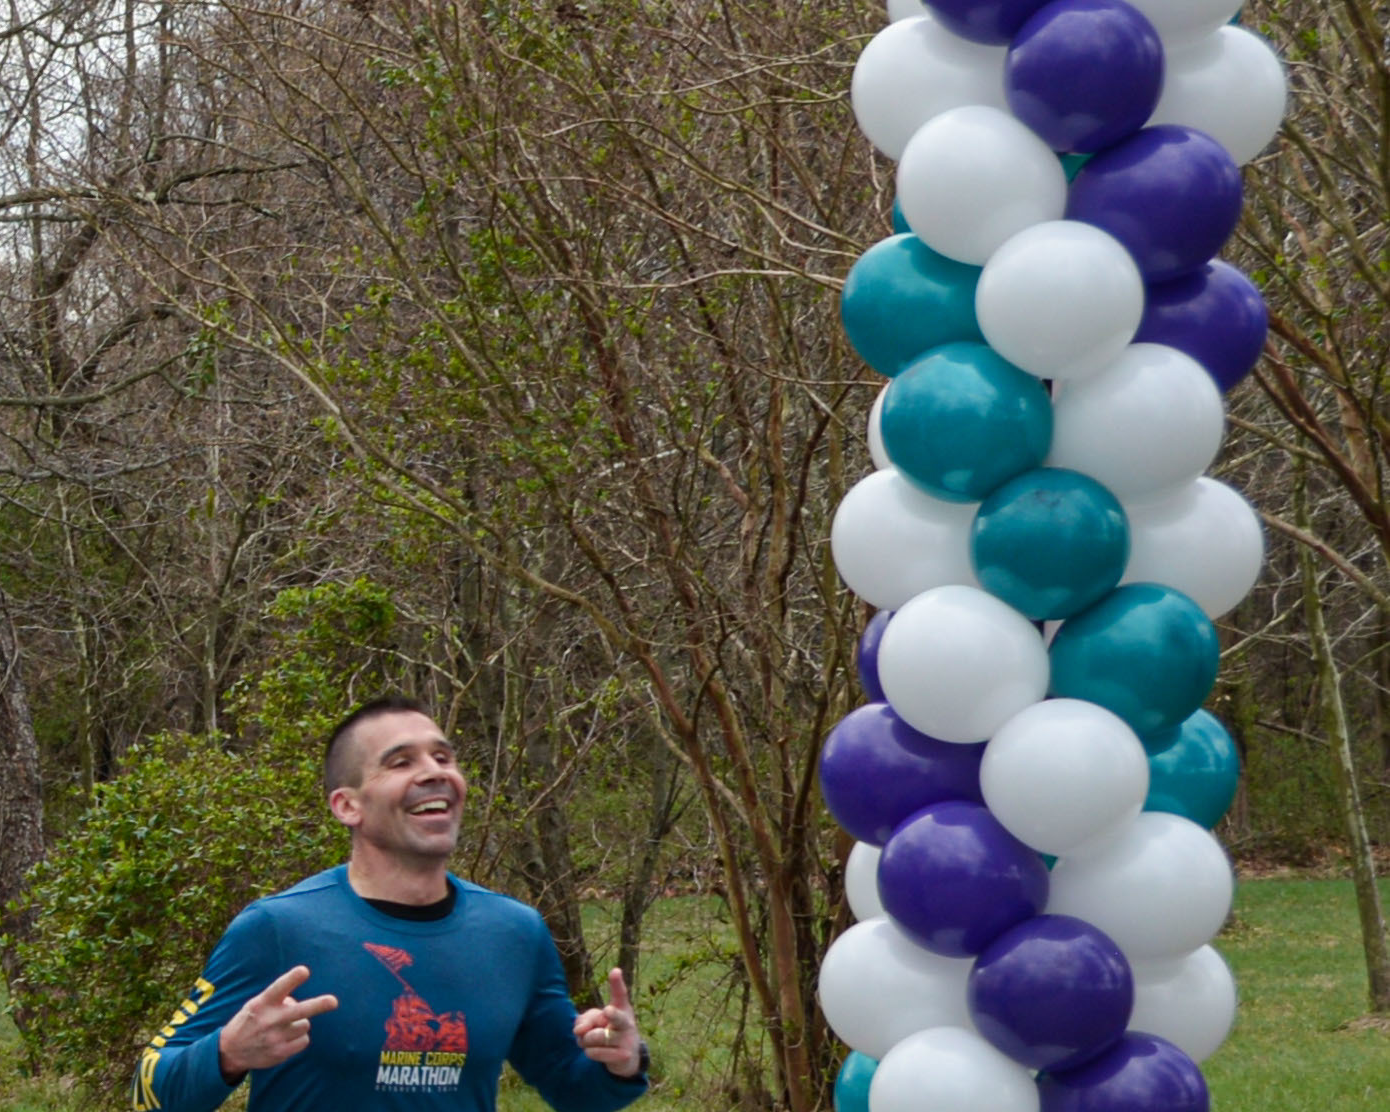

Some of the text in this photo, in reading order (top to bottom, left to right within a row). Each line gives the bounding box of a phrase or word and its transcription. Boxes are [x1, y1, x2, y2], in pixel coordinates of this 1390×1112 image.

[380, 1051, 466, 1066] MARINE CORPS
[376, 1066, 461, 1085] MARATHON
